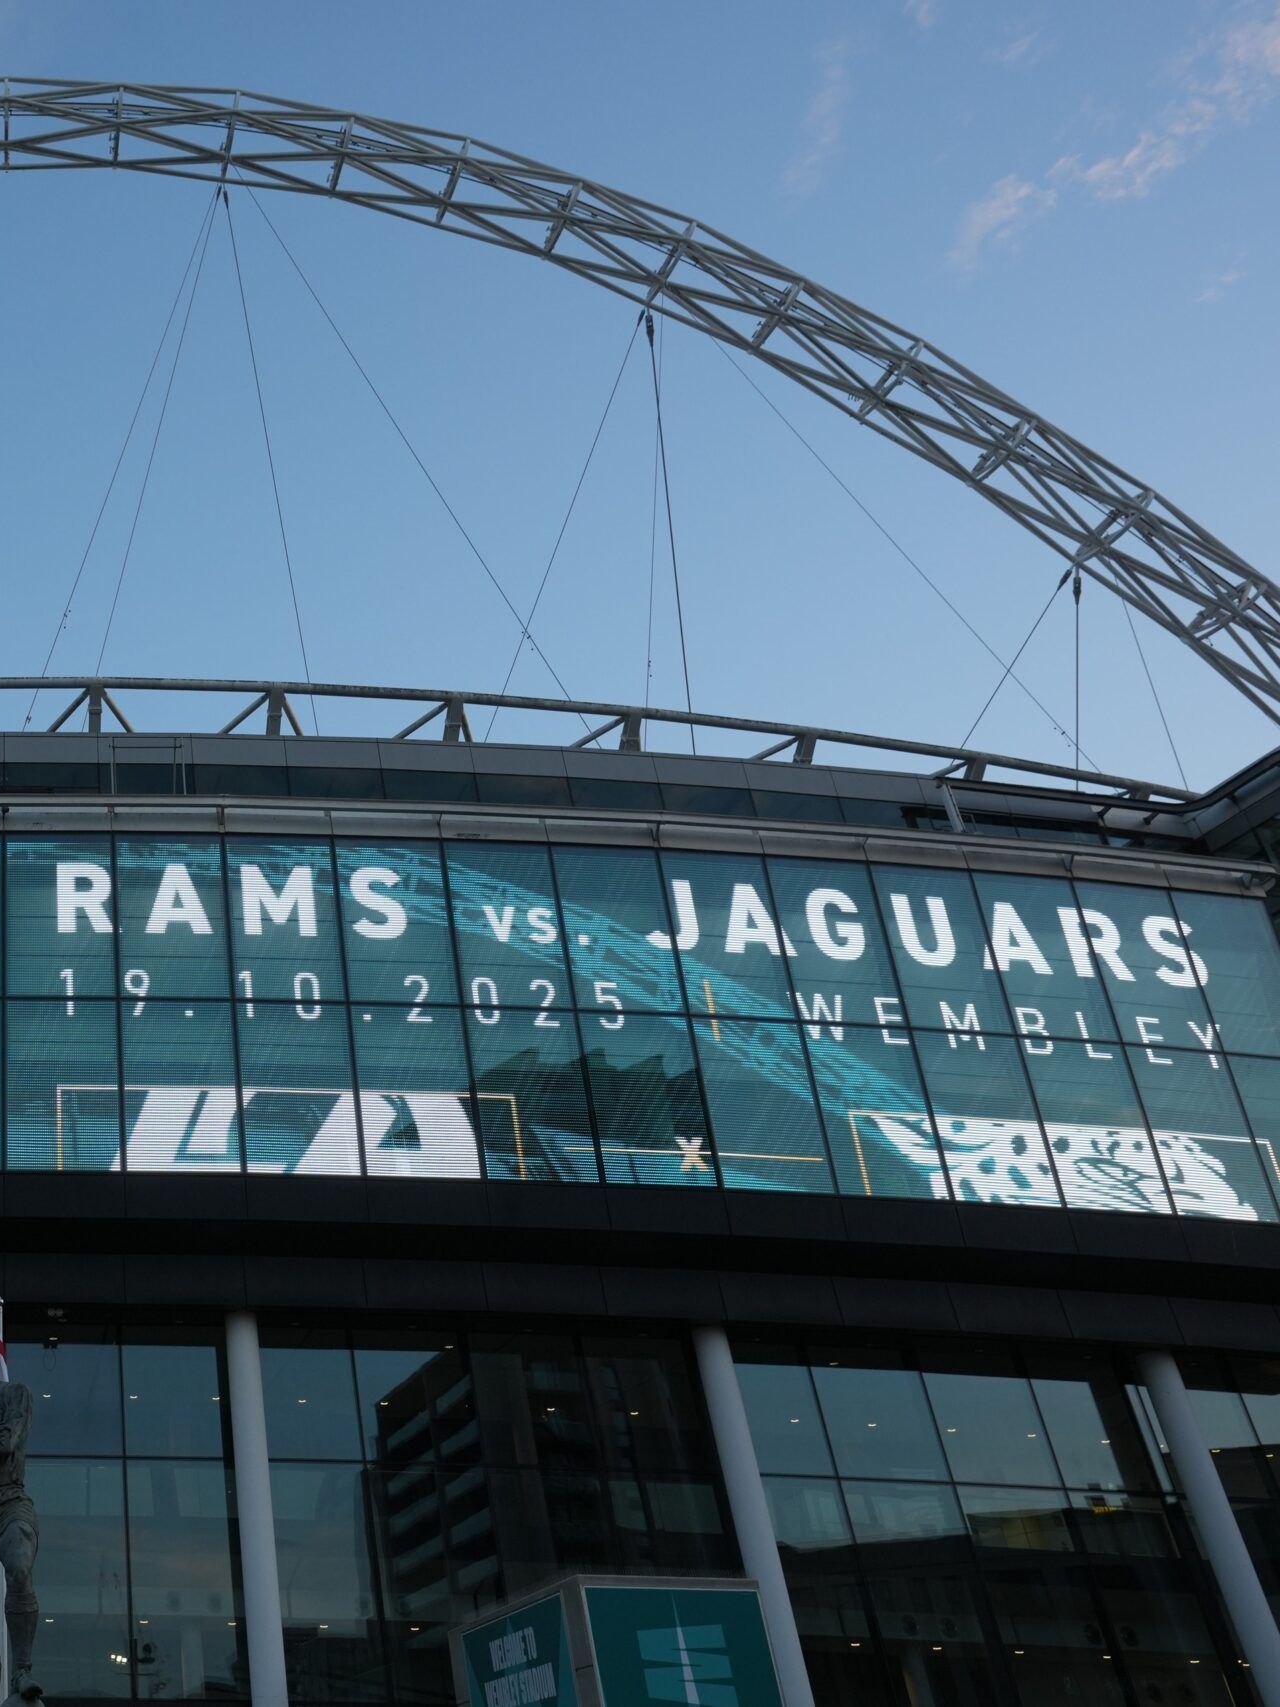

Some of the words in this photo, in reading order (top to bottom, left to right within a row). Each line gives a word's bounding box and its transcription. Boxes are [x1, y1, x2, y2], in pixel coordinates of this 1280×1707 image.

[56, 861, 409, 940] RAMS
[647, 879, 1210, 989] JAGUARS
[59, 968, 625, 1031] 19.10.2025
[789, 991, 1222, 1069] WEMBLEY
[484, 1673, 521, 1707] WEMBLEY
[518, 1662, 557, 1704] STADIUM
[488, 1629, 528, 1672] WELCOME
[523, 1626, 538, 1661] TO
